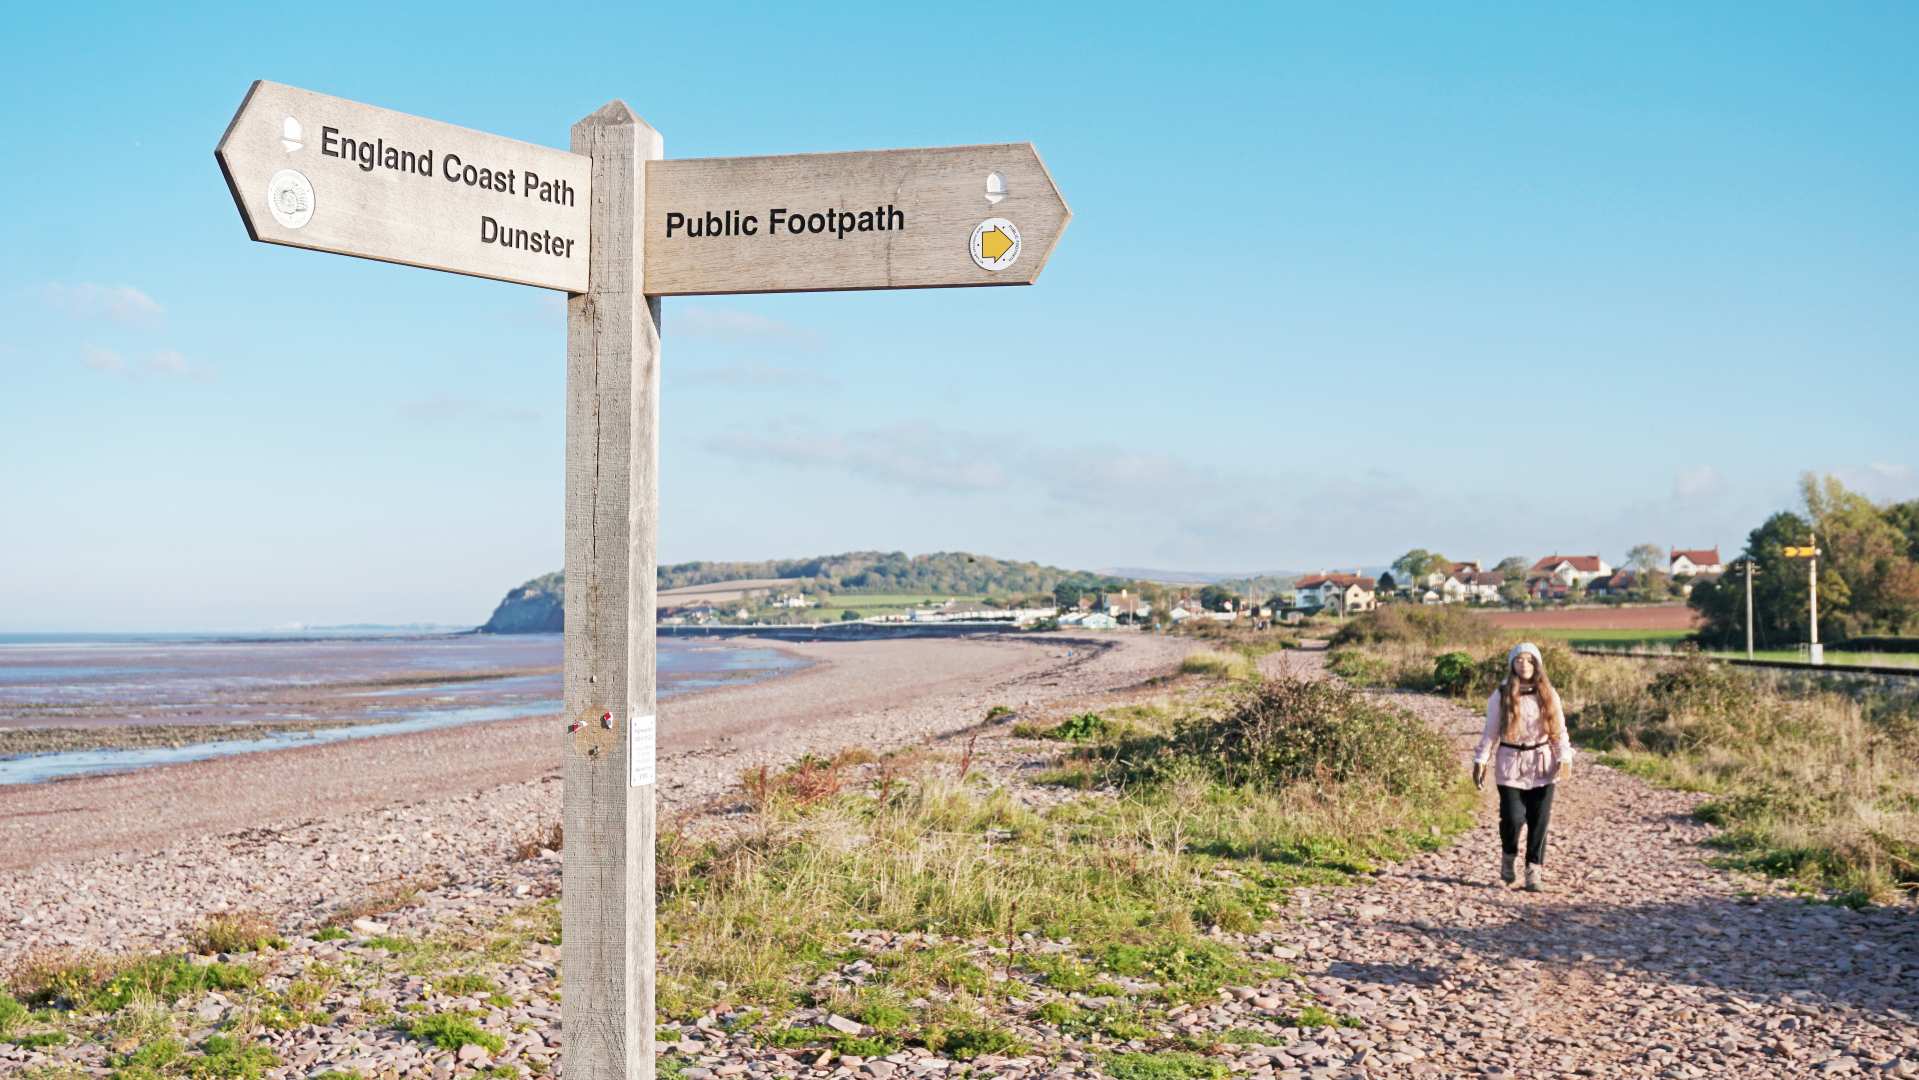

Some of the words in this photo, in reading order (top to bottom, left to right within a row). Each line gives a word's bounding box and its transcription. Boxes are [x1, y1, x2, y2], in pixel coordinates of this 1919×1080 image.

[321, 125, 433, 178] England
[442, 153, 516, 195] Coast
[524, 171, 575, 208] Path
[481, 215, 575, 258] Dunster
[666, 208, 758, 238] Public
[769, 204, 904, 240] Footpath
